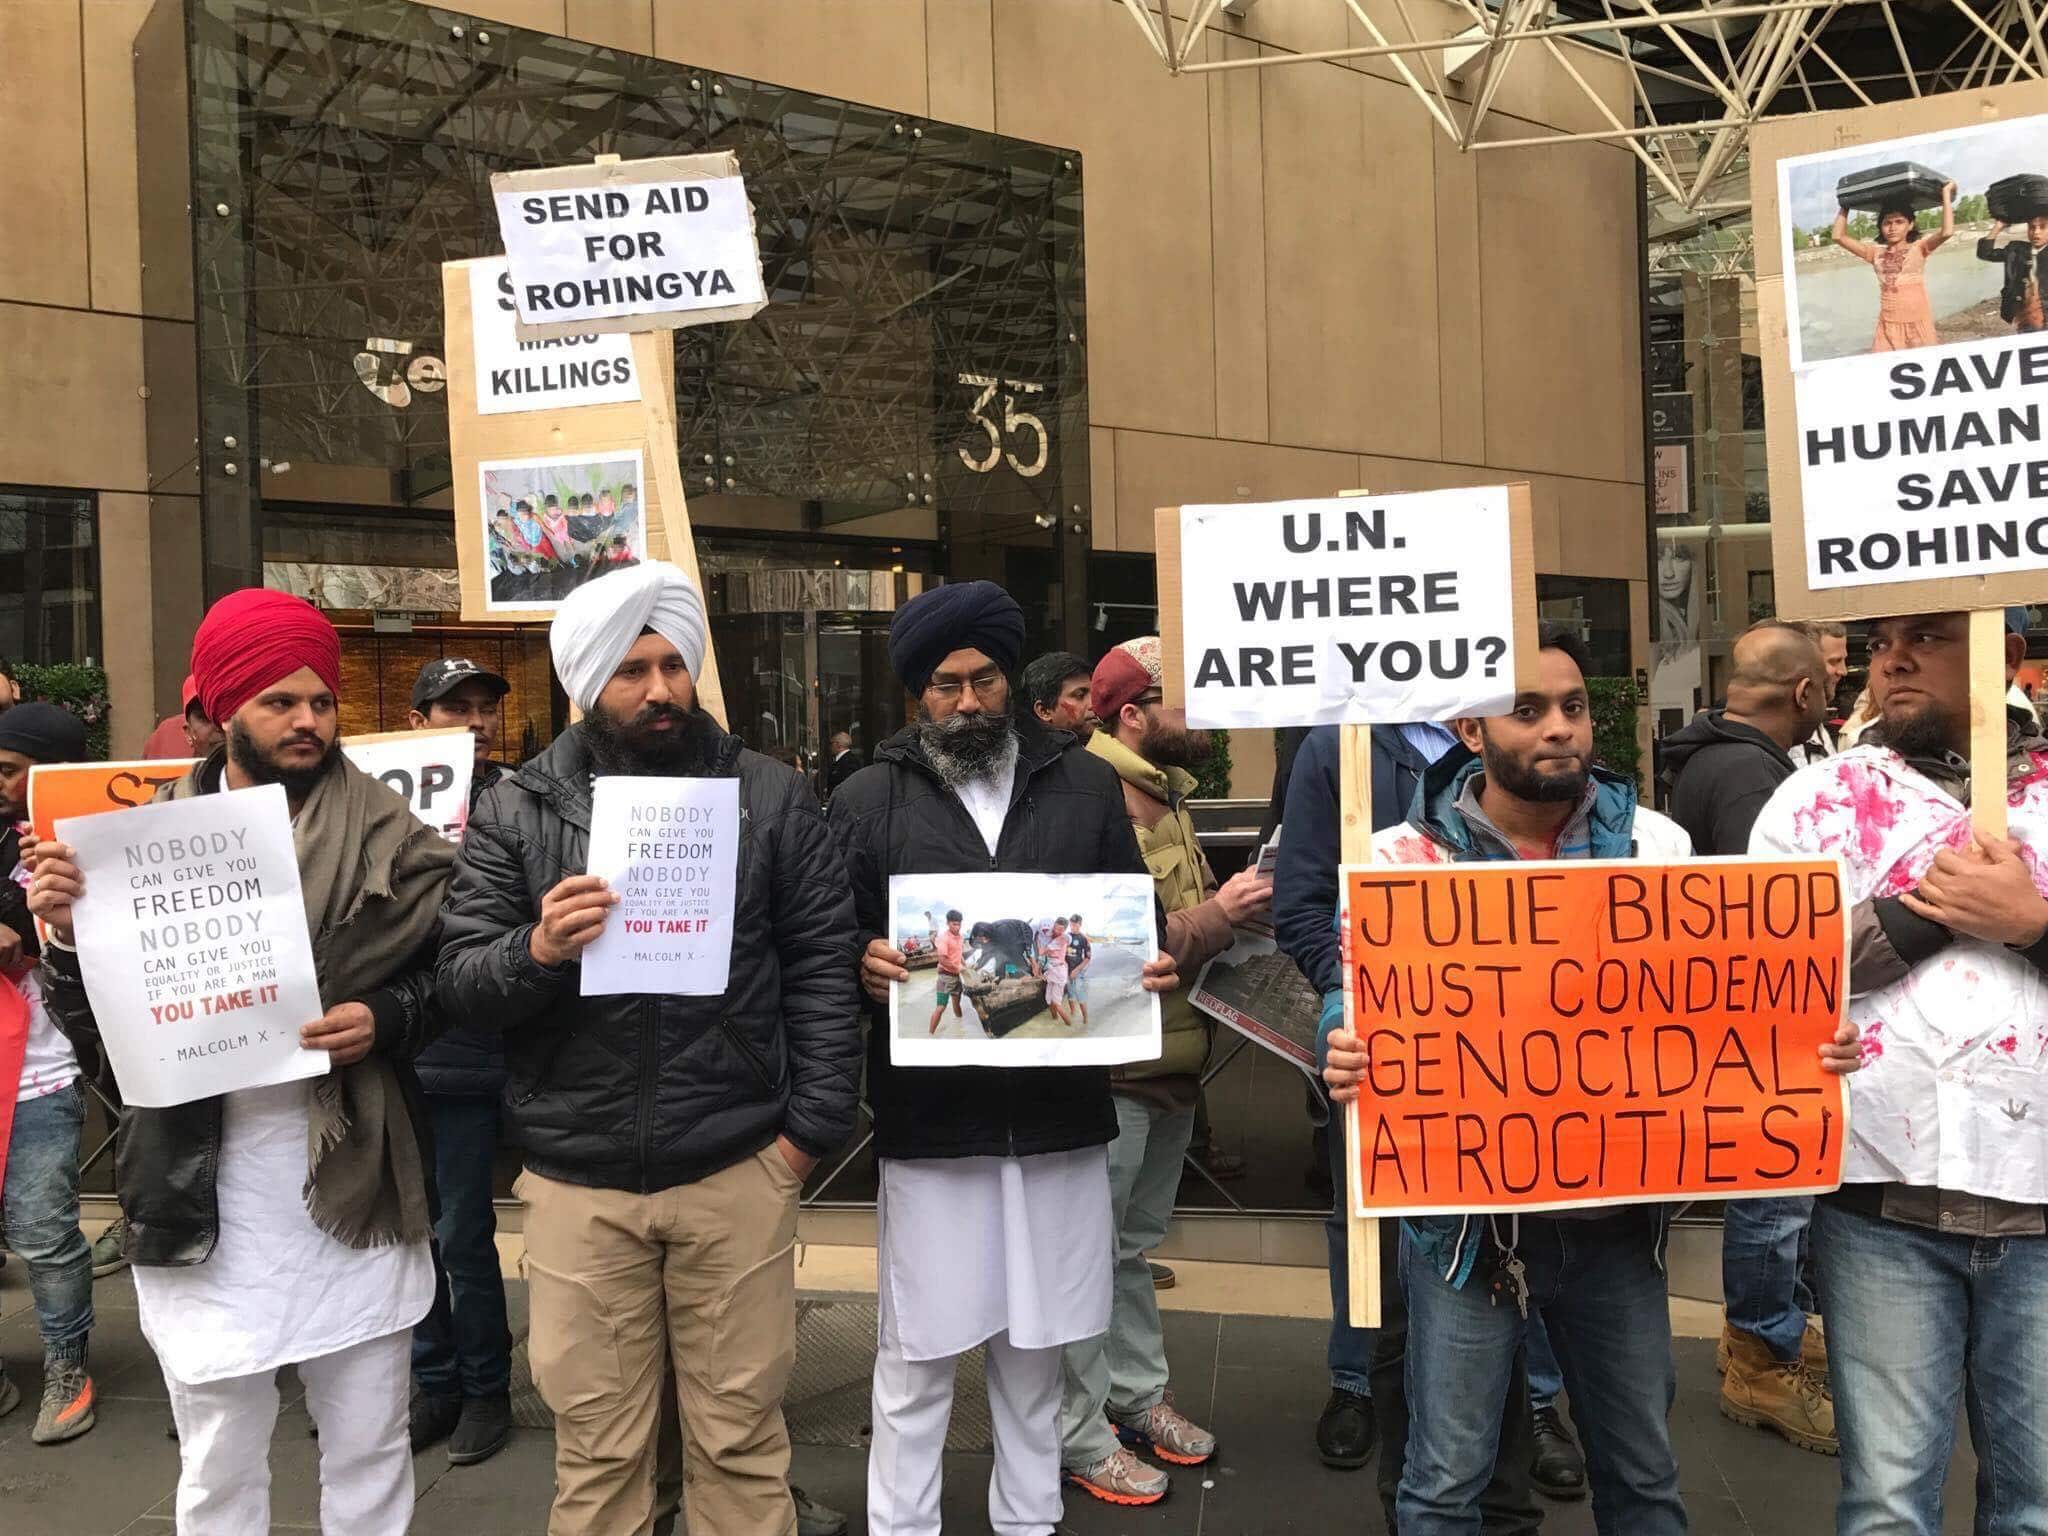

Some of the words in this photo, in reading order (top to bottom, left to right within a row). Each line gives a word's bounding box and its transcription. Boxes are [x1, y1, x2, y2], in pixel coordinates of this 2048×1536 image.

[522, 191, 630, 225] SEND
[645, 185, 710, 216] AID
[584, 230, 666, 263] FOR
[525, 267, 736, 312] ROHINGYA
[491, 356, 632, 397] KILLINGS
[1889, 345, 2048, 400] SAVE
[958, 372, 1048, 477] 35
[1806, 403, 2041, 467] HUMAN
[1896, 460, 2048, 512] SAVE
[1282, 508, 1406, 554] U.N.
[1232, 570, 1460, 623] WHERE
[1193, 644, 1316, 689] ARE
[1337, 635, 1508, 684] YOU?
[379, 763, 455, 810] OP
[629, 827, 651, 838] CAN
[658, 828, 686, 839] GIVE
[694, 828, 714, 839] YOU
[631, 805, 714, 823] NOBODY
[124, 827, 247, 869] NOBODY
[628, 843, 713, 859] FREEDOM
[130, 872, 163, 890] CAN
[173, 863, 216, 882] GIVE
[225, 856, 257, 873] YOU
[626, 887, 648, 897] CAN
[655, 887, 683, 898] GIVE
[690, 887, 710, 897] YOU
[628, 866, 710, 882] NOBODY
[133, 877, 262, 920] FREEDOM
[625, 908, 635, 916] IF
[640, 908, 657, 916] YOU
[662, 908, 679, 916] ARE
[693, 908, 709, 916] MAN
[1360, 873, 1565, 948] JULIE
[1608, 871, 1841, 944] BISHOP
[139, 909, 263, 953] NOBODY
[624, 920, 653, 933] YOU
[657, 920, 692, 933] TAKE
[695, 919, 709, 933] IT
[143, 956, 177, 974] CAN
[187, 946, 229, 966] GIVE
[240, 938, 272, 956] YOU
[144, 969, 200, 988] EQUALITY
[206, 965, 221, 977] OR
[228, 956, 274, 973] JUSTICE
[634, 951, 682, 961] MALCOLM
[687, 951, 695, 961] X
[147, 989, 162, 1001] IF
[171, 983, 196, 997] YOU
[204, 977, 227, 991] ARE
[236, 974, 245, 985] A
[252, 968, 277, 982] MAN
[150, 1000, 194, 1025] YOU
[200, 989, 255, 1016] TAKE
[258, 984, 279, 1005] IT
[1359, 962, 1522, 1019] MUST
[1549, 953, 1837, 1019] CONDEMN
[176, 1035, 249, 1062] MALCOLM
[257, 1030, 269, 1043] X
[1367, 1024, 1823, 1099] GENOCIDAL
[1369, 1103, 1833, 1196] ATROCITIES!
